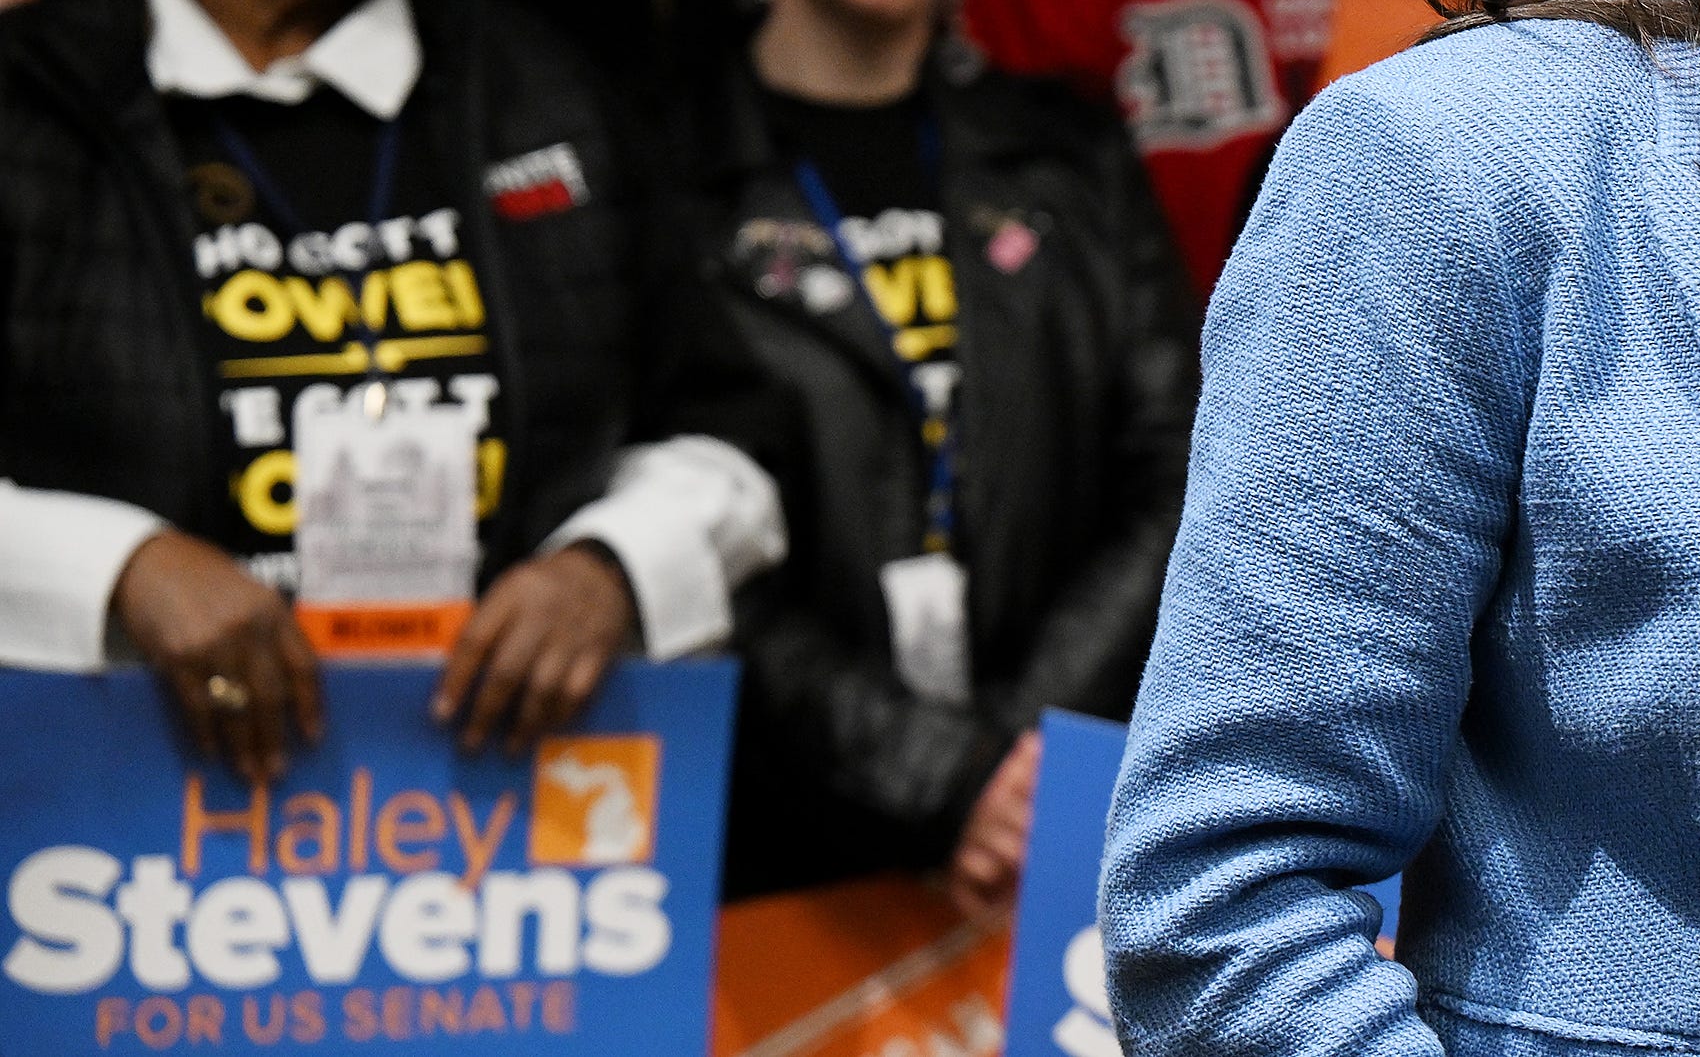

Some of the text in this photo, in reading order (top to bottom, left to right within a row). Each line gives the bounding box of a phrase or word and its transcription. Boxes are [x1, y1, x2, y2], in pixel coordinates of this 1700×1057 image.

[181, 766, 516, 896] Haley
[3, 845, 672, 994] Stevens
[95, 979, 578, 1048] FOR US SENATE
